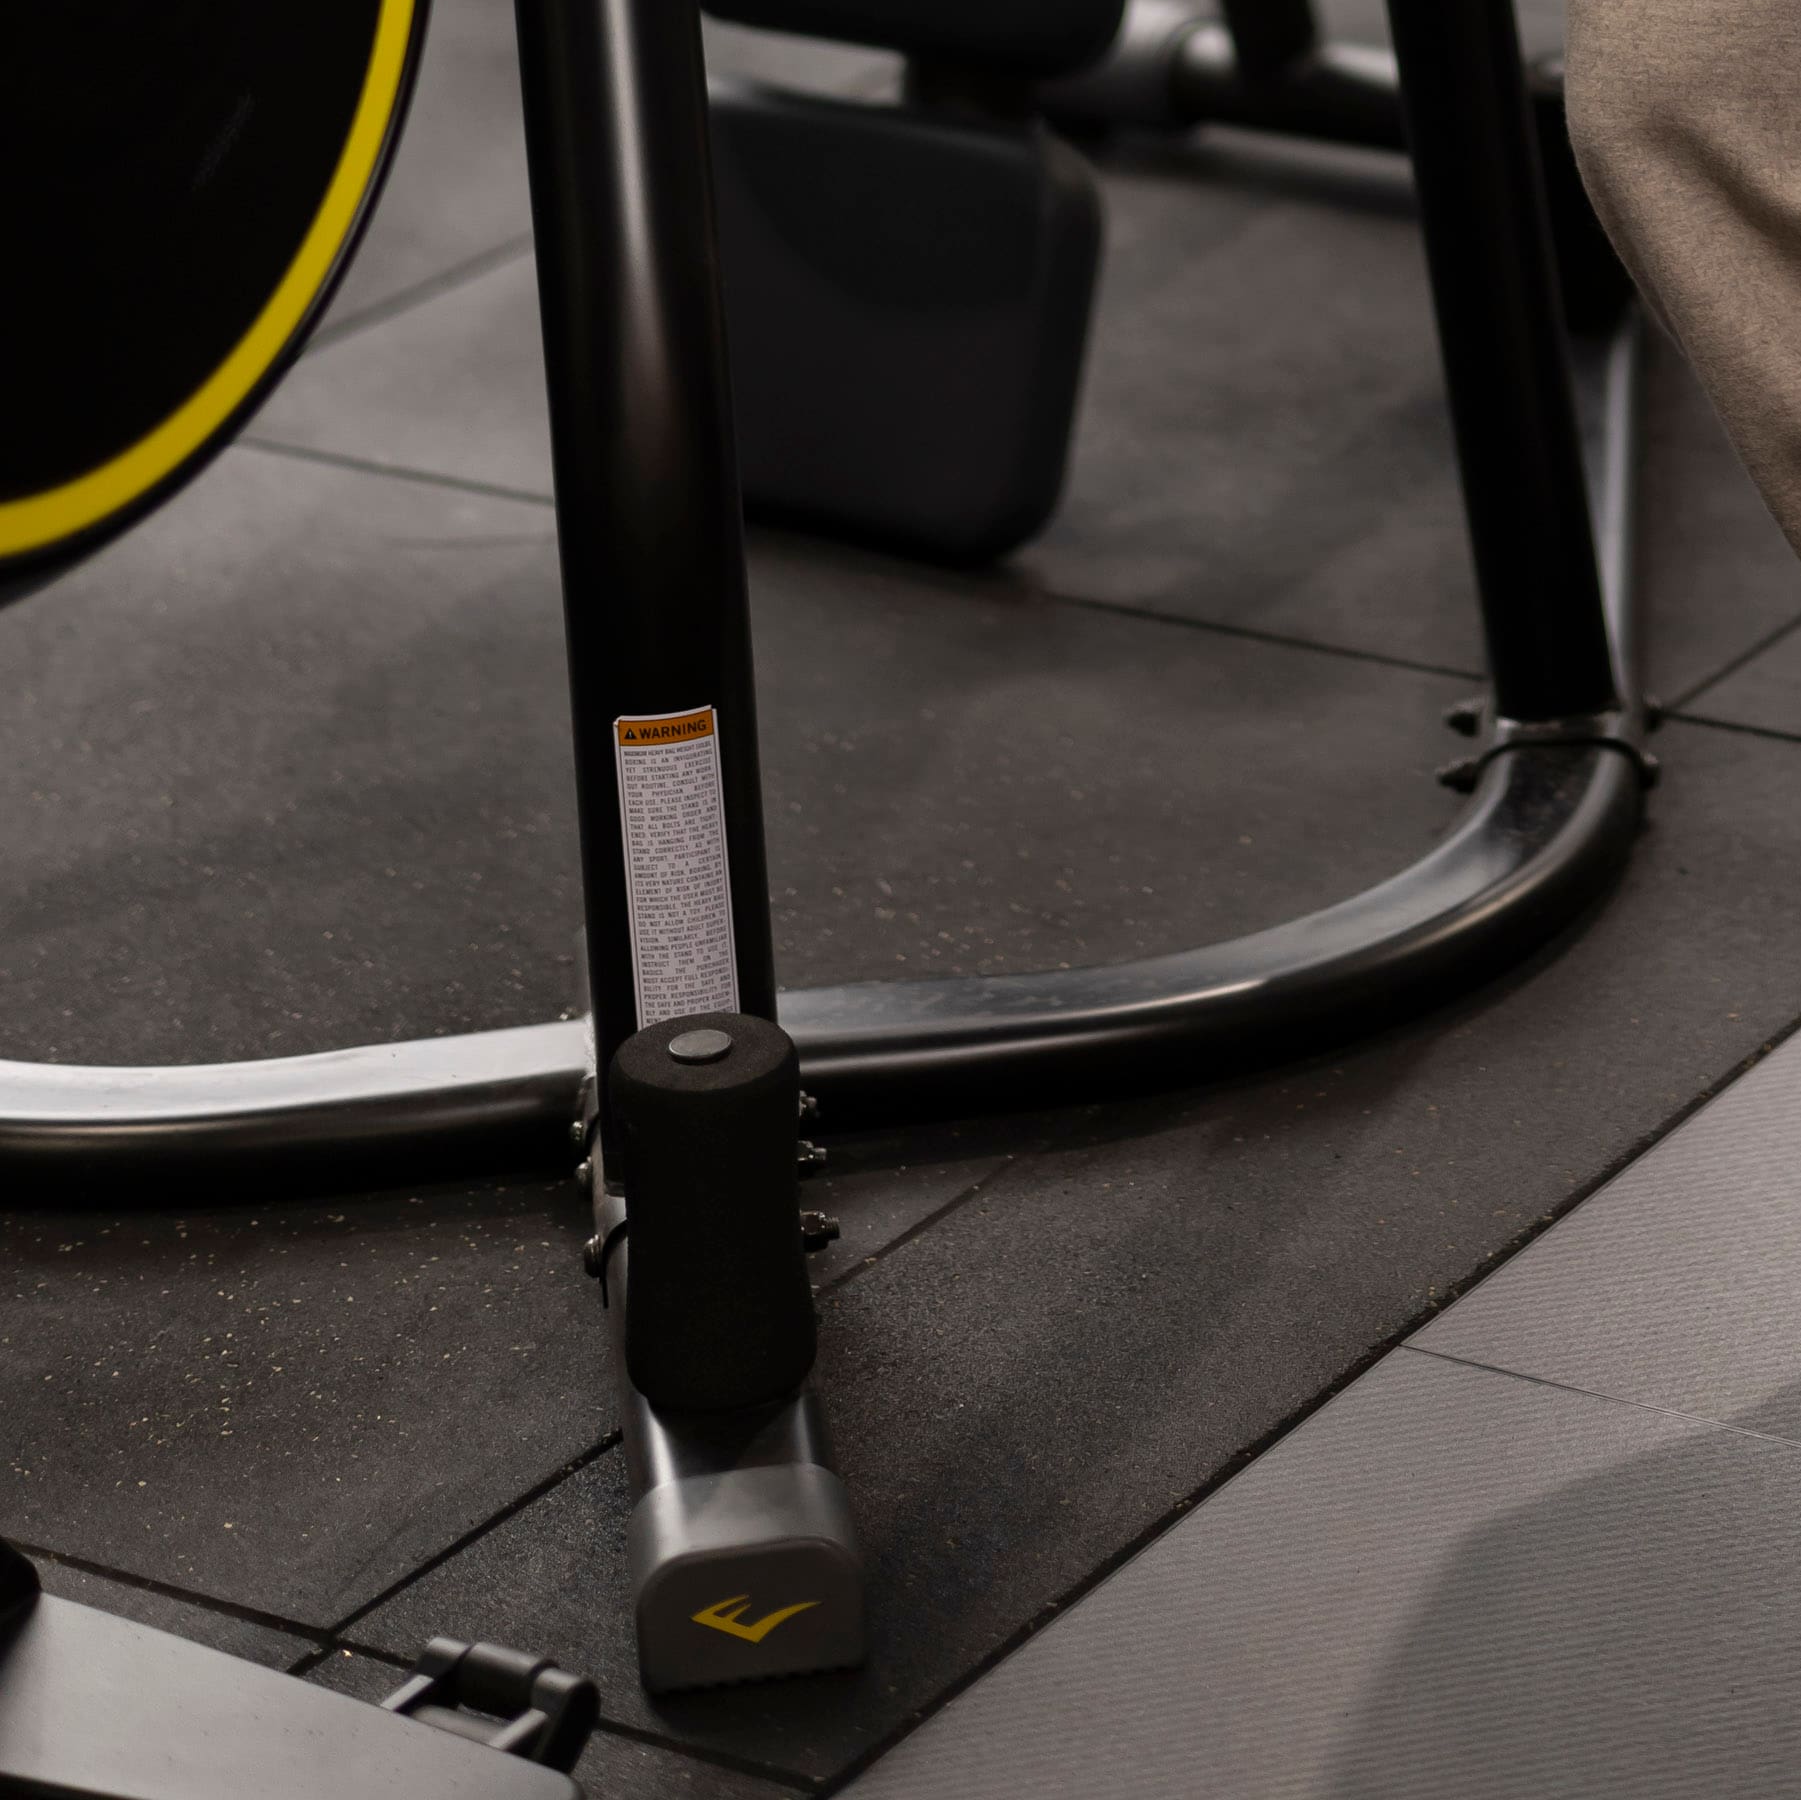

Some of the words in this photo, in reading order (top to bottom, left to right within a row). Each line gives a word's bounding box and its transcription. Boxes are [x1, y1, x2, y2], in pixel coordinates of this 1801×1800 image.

[639, 719, 707, 739] WARNING
[665, 747, 675, 755] BAG
[677, 744, 694, 753] WEIGHT
[673, 748, 712, 762] INVIGORATING
[643, 764, 677, 773] STRENUOUS
[652, 771, 679, 781] STARTING
[682, 769, 693, 777] ANY
[672, 776, 698, 787] CONSULT
[702, 772, 714, 782] WITH
[694, 781, 714, 791] BEFORE
[660, 796, 681, 804] PLEASE
[684, 791, 707, 801] INSPECT
[650, 813, 677, 821] WORKING
[683, 808, 701, 818] ORDER
[707, 805, 717, 813] AND
[667, 804, 677, 812] THE
[681, 801, 699, 810] STAND
[650, 830, 670, 838] VERIFY
[673, 828, 686, 836] THAT
[689, 825, 699, 833] THE
[702, 821, 718, 831] HEAVY
[662, 820, 680, 829] BOLTS
[685, 818, 695, 826] ARE
[658, 836, 684, 845] HANGING
[689, 832, 705, 841] FROM
[709, 829, 718, 837] THE
[707, 837, 719, 846] WITH
[674, 847, 710, 860] PARTICIPANT
[698, 853, 721, 864] CERTAIN
[686, 871, 713, 883] CONTAINS
[676, 884, 690, 892] RISK
[704, 878, 722, 888] INJURY
[683, 891, 698, 900] USER
[700, 888, 714, 897] MUST
[681, 900, 691, 908] THE
[694, 897, 711, 906] HEAVY
[714, 894, 724, 902] BAG
[668, 910, 679, 918] NOT
[705, 902, 724, 912] PLEASE
[665, 918, 684, 926] ALLOW
[687, 912, 716, 923] CHILDREN
[659, 926, 684, 934] WITHOUT
[687, 923, 704, 932] ADULT
[706, 926, 726, 937] BEFORE
[671, 941, 692, 950] PEOPLE
[695, 934, 727, 947] UNFAMILIAR
[674, 949, 692, 958] STAND
[708, 945, 717, 953] USE
[679, 957, 694, 965] THEM
[719, 950, 728, 958] THE
[697, 958, 729, 971] PURCHASER
[660, 975, 682, 983] ACCEPT
[685, 973, 698, 981] FULL
[702, 978, 714, 987] SAFE
[720, 974, 730, 983] AND
[671, 986, 717, 999] RESPONSIBILITY
[721, 982, 731, 991] FOR
[673, 999, 685, 1007] AND
[687, 996, 709, 1005] PROPER
[674, 1007, 685, 1015] USE
